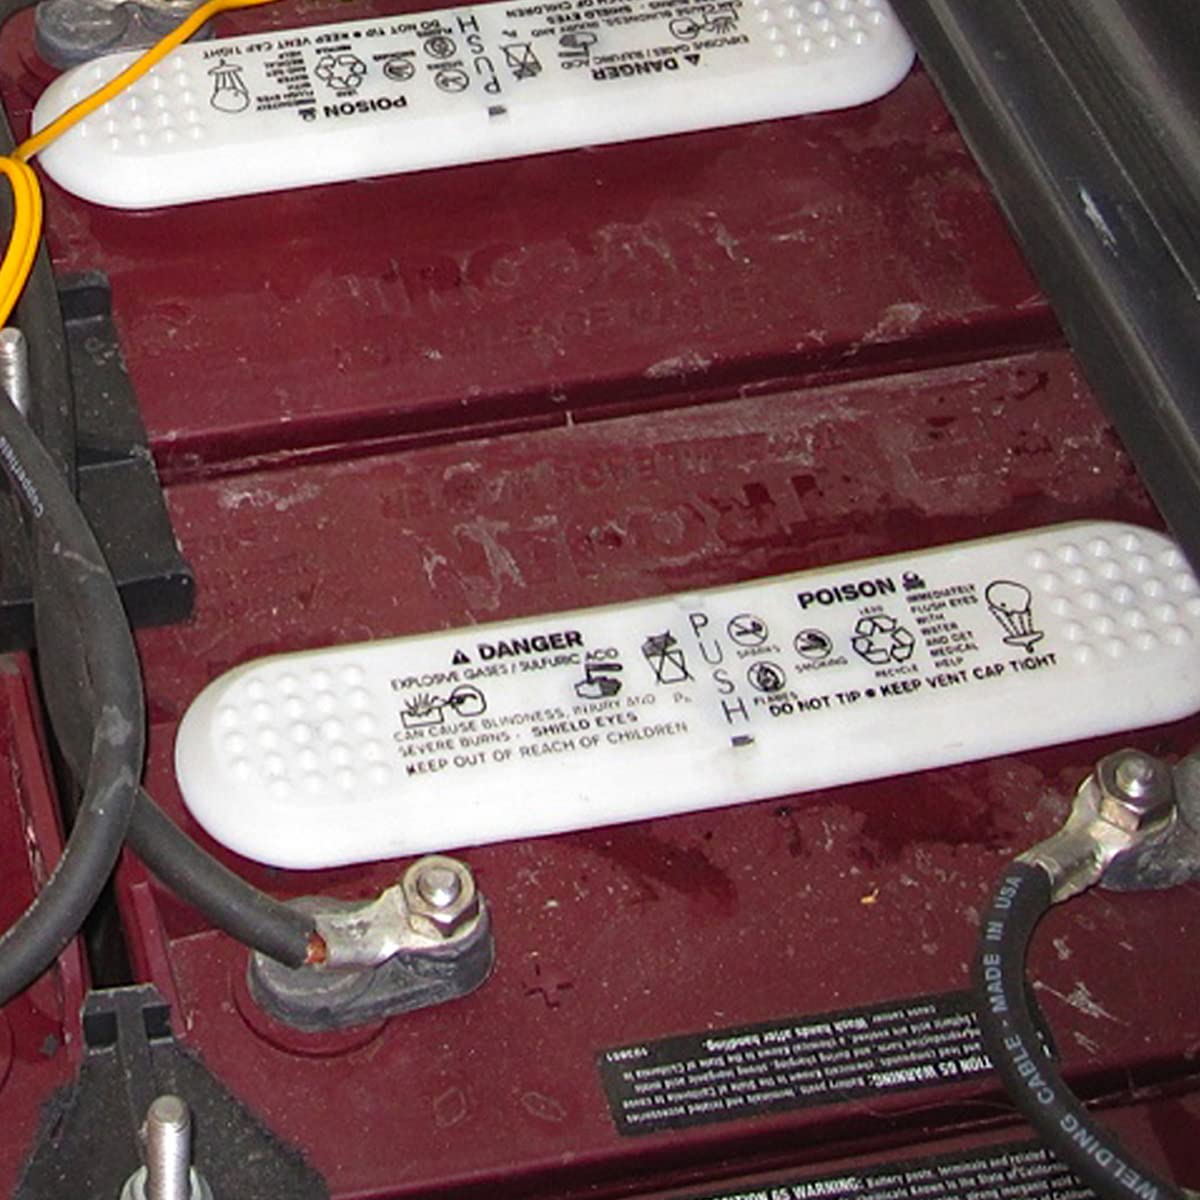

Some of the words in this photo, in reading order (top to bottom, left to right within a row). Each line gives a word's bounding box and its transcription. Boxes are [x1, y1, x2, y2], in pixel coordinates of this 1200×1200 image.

[506, 1, 573, 17] CHILDREN
[575, 0, 594, 10] OF
[366, 28, 386, 39] TIP
[390, 23, 417, 35] NOT
[420, 20, 440, 29] DO
[246, 43, 272, 54] CAP
[277, 37, 311, 50] VENT
[315, 32, 349, 45] KEEP
[203, 47, 241, 60] TIGHT
[591, 58, 680, 82] DANGER
[324, 96, 407, 118] POISON
[797, 578, 896, 610] POISON
[478, 630, 583, 660] DANGER
[688, 612, 750, 724] PUSH
[769, 702, 794, 717] DO
[797, 695, 831, 712] NOT
[836, 689, 862, 707] TIP
[879, 679, 923, 698] KEEP
[929, 670, 969, 689] VENT
[973, 663, 1005, 681] CAP
[1010, 653, 1058, 674] TIGHT
[398, 739, 454, 757] SEVERE
[460, 732, 511, 749] BURNS
[531, 717, 591, 738] SHIELD
[596, 712, 638, 729] EYES
[406, 759, 449, 777] KEEP
[453, 754, 487, 769] OUT
[493, 750, 514, 763] OF
[519, 741, 575, 759] REACH
[580, 736, 601, 749] OF
[606, 722, 689, 746] CHILDREN
[995, 876, 1022, 909] USA
[986, 922, 1003, 940] IN
[983, 953, 1008, 1013] MADE
[870, 1068, 938, 1087] WARNING:
[1004, 1033, 1054, 1104] CABLE
[1060, 1114, 1158, 1200] WELDING
